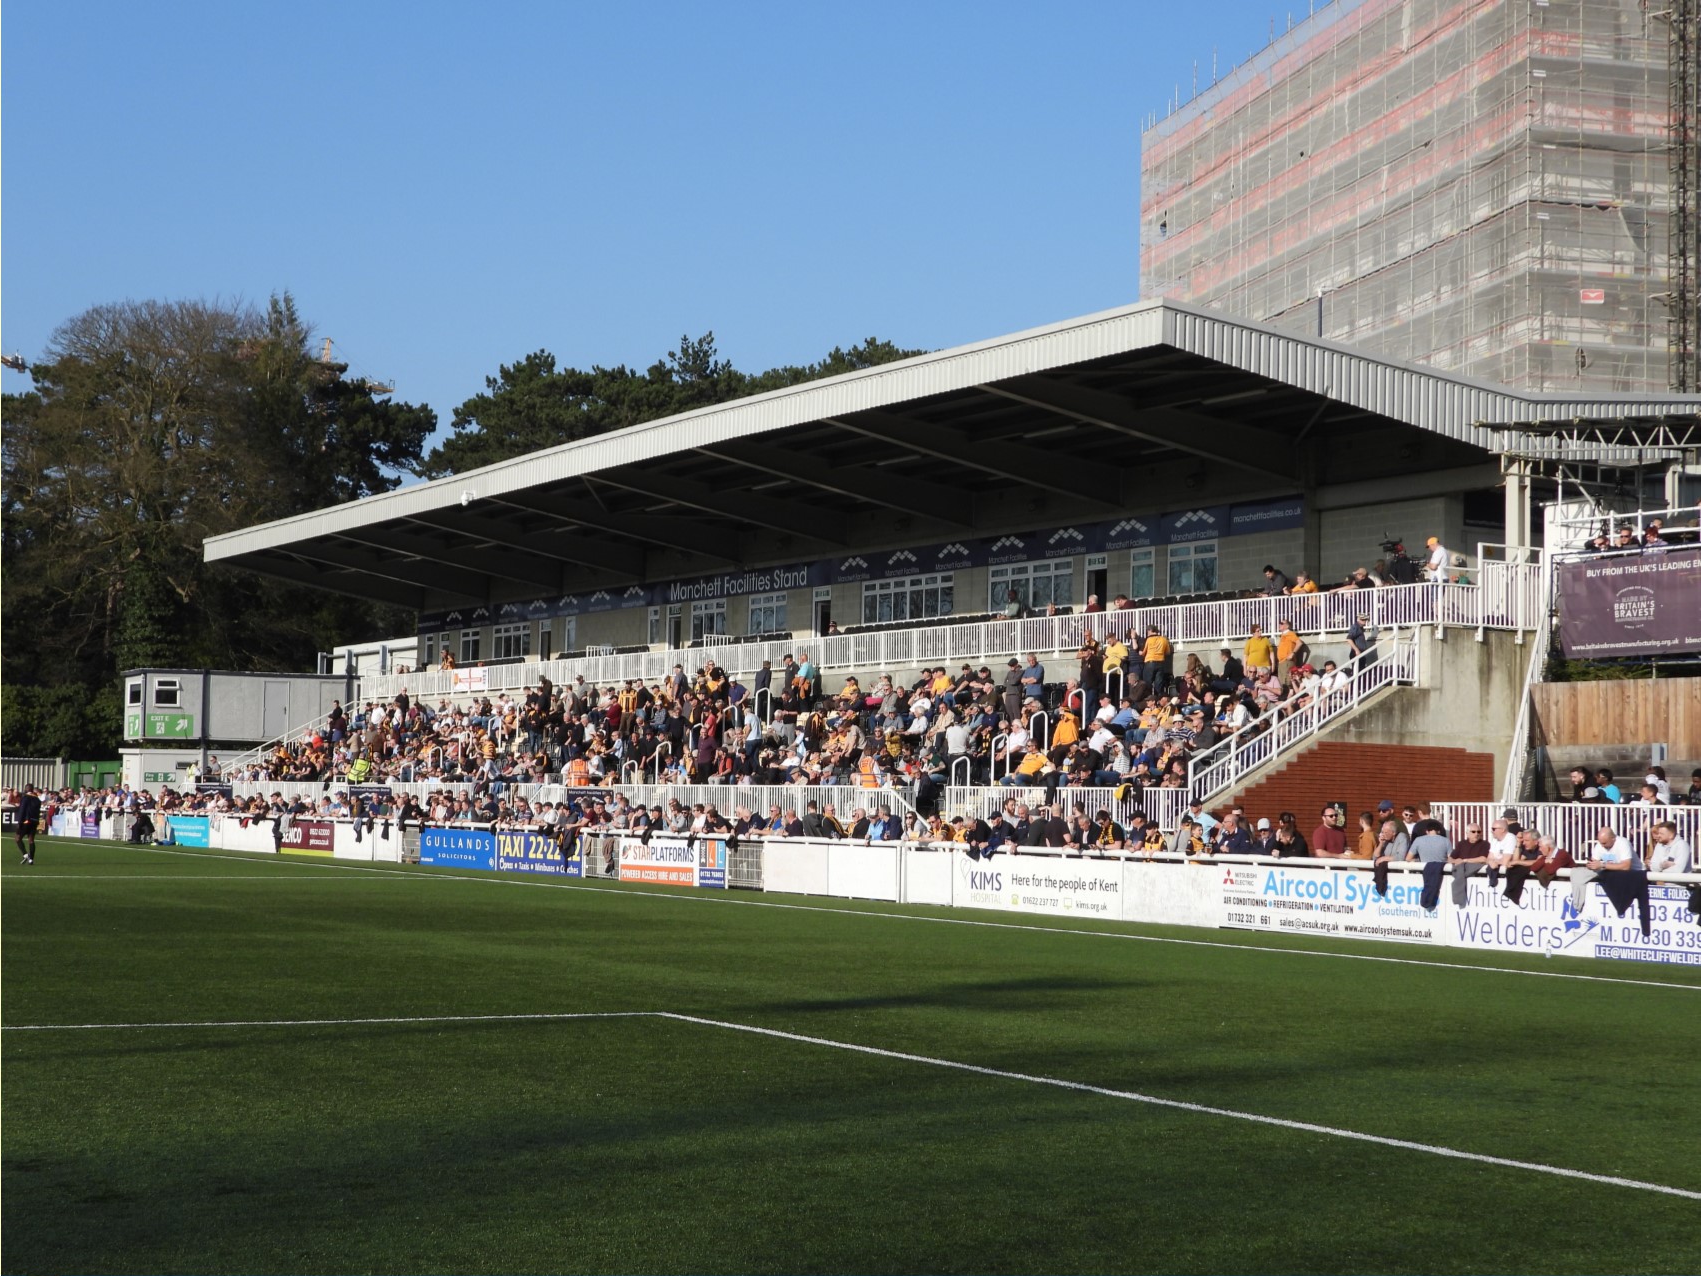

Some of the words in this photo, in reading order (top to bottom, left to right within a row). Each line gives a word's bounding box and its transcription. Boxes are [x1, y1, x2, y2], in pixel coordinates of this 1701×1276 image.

[1586, 568, 1601, 578] BUY
[1602, 566, 1623, 577] FROM
[1624, 565, 1638, 575] THE
[1639, 564, 1656, 573] UK'S
[1658, 561, 1691, 571] LEADING
[670, 576, 721, 601] Manchett
[724, 571, 770, 595] Facilities
[774, 565, 807, 588] Stand
[1614, 600, 1655, 611] BRITAIN'S
[1614, 608, 1655, 618] BRAVEST
[425, 835, 490, 852] GULLANDS
[499, 835, 525, 858] TAXI
[438, 853, 476, 861] SOLICITORS
[633, 845, 695, 863] STARPLATFORMS
[621, 868, 641, 879] POWERED
[641, 869, 657, 880] ACCESS
[657, 870, 669, 881] HIRE
[669, 870, 679, 881] AND
[679, 871, 693, 882] SALES
[970, 870, 1002, 892] KIMS
[1011, 872, 1030, 886] Here
[1031, 873, 1043, 887] for
[1044, 875, 1058, 889] the
[1058, 876, 1087, 894] people
[1088, 878, 1098, 891] of
[1099, 879, 1118, 893] Kent
[1263, 870, 1339, 900] Aircool
[970, 892, 1002, 905] HOSPITAL
[1022, 896, 1039, 906] 01622
[1039, 897, 1049, 907] 237
[1049, 898, 1059, 907] 727
[1075, 900, 1107, 912] kims.org.uk
[1223, 896, 1232, 905] AIR
[1232, 897, 1268, 908] CONDITIONING
[1273, 899, 1314, 911] REFRIGERATION
[1319, 903, 1354, 914] VENTILATION
[1227, 911, 1245, 922] 01732
[1245, 913, 1256, 923] 321
[1260, 914, 1271, 925] 661
[1378, 906, 1421, 918] (southern)
[1279, 917, 1339, 933] sales@acsuk.org.uk
[1344, 923, 1433, 939] www.aircoolsystemsuk.co.uk
[1456, 910, 1563, 949] Welders
